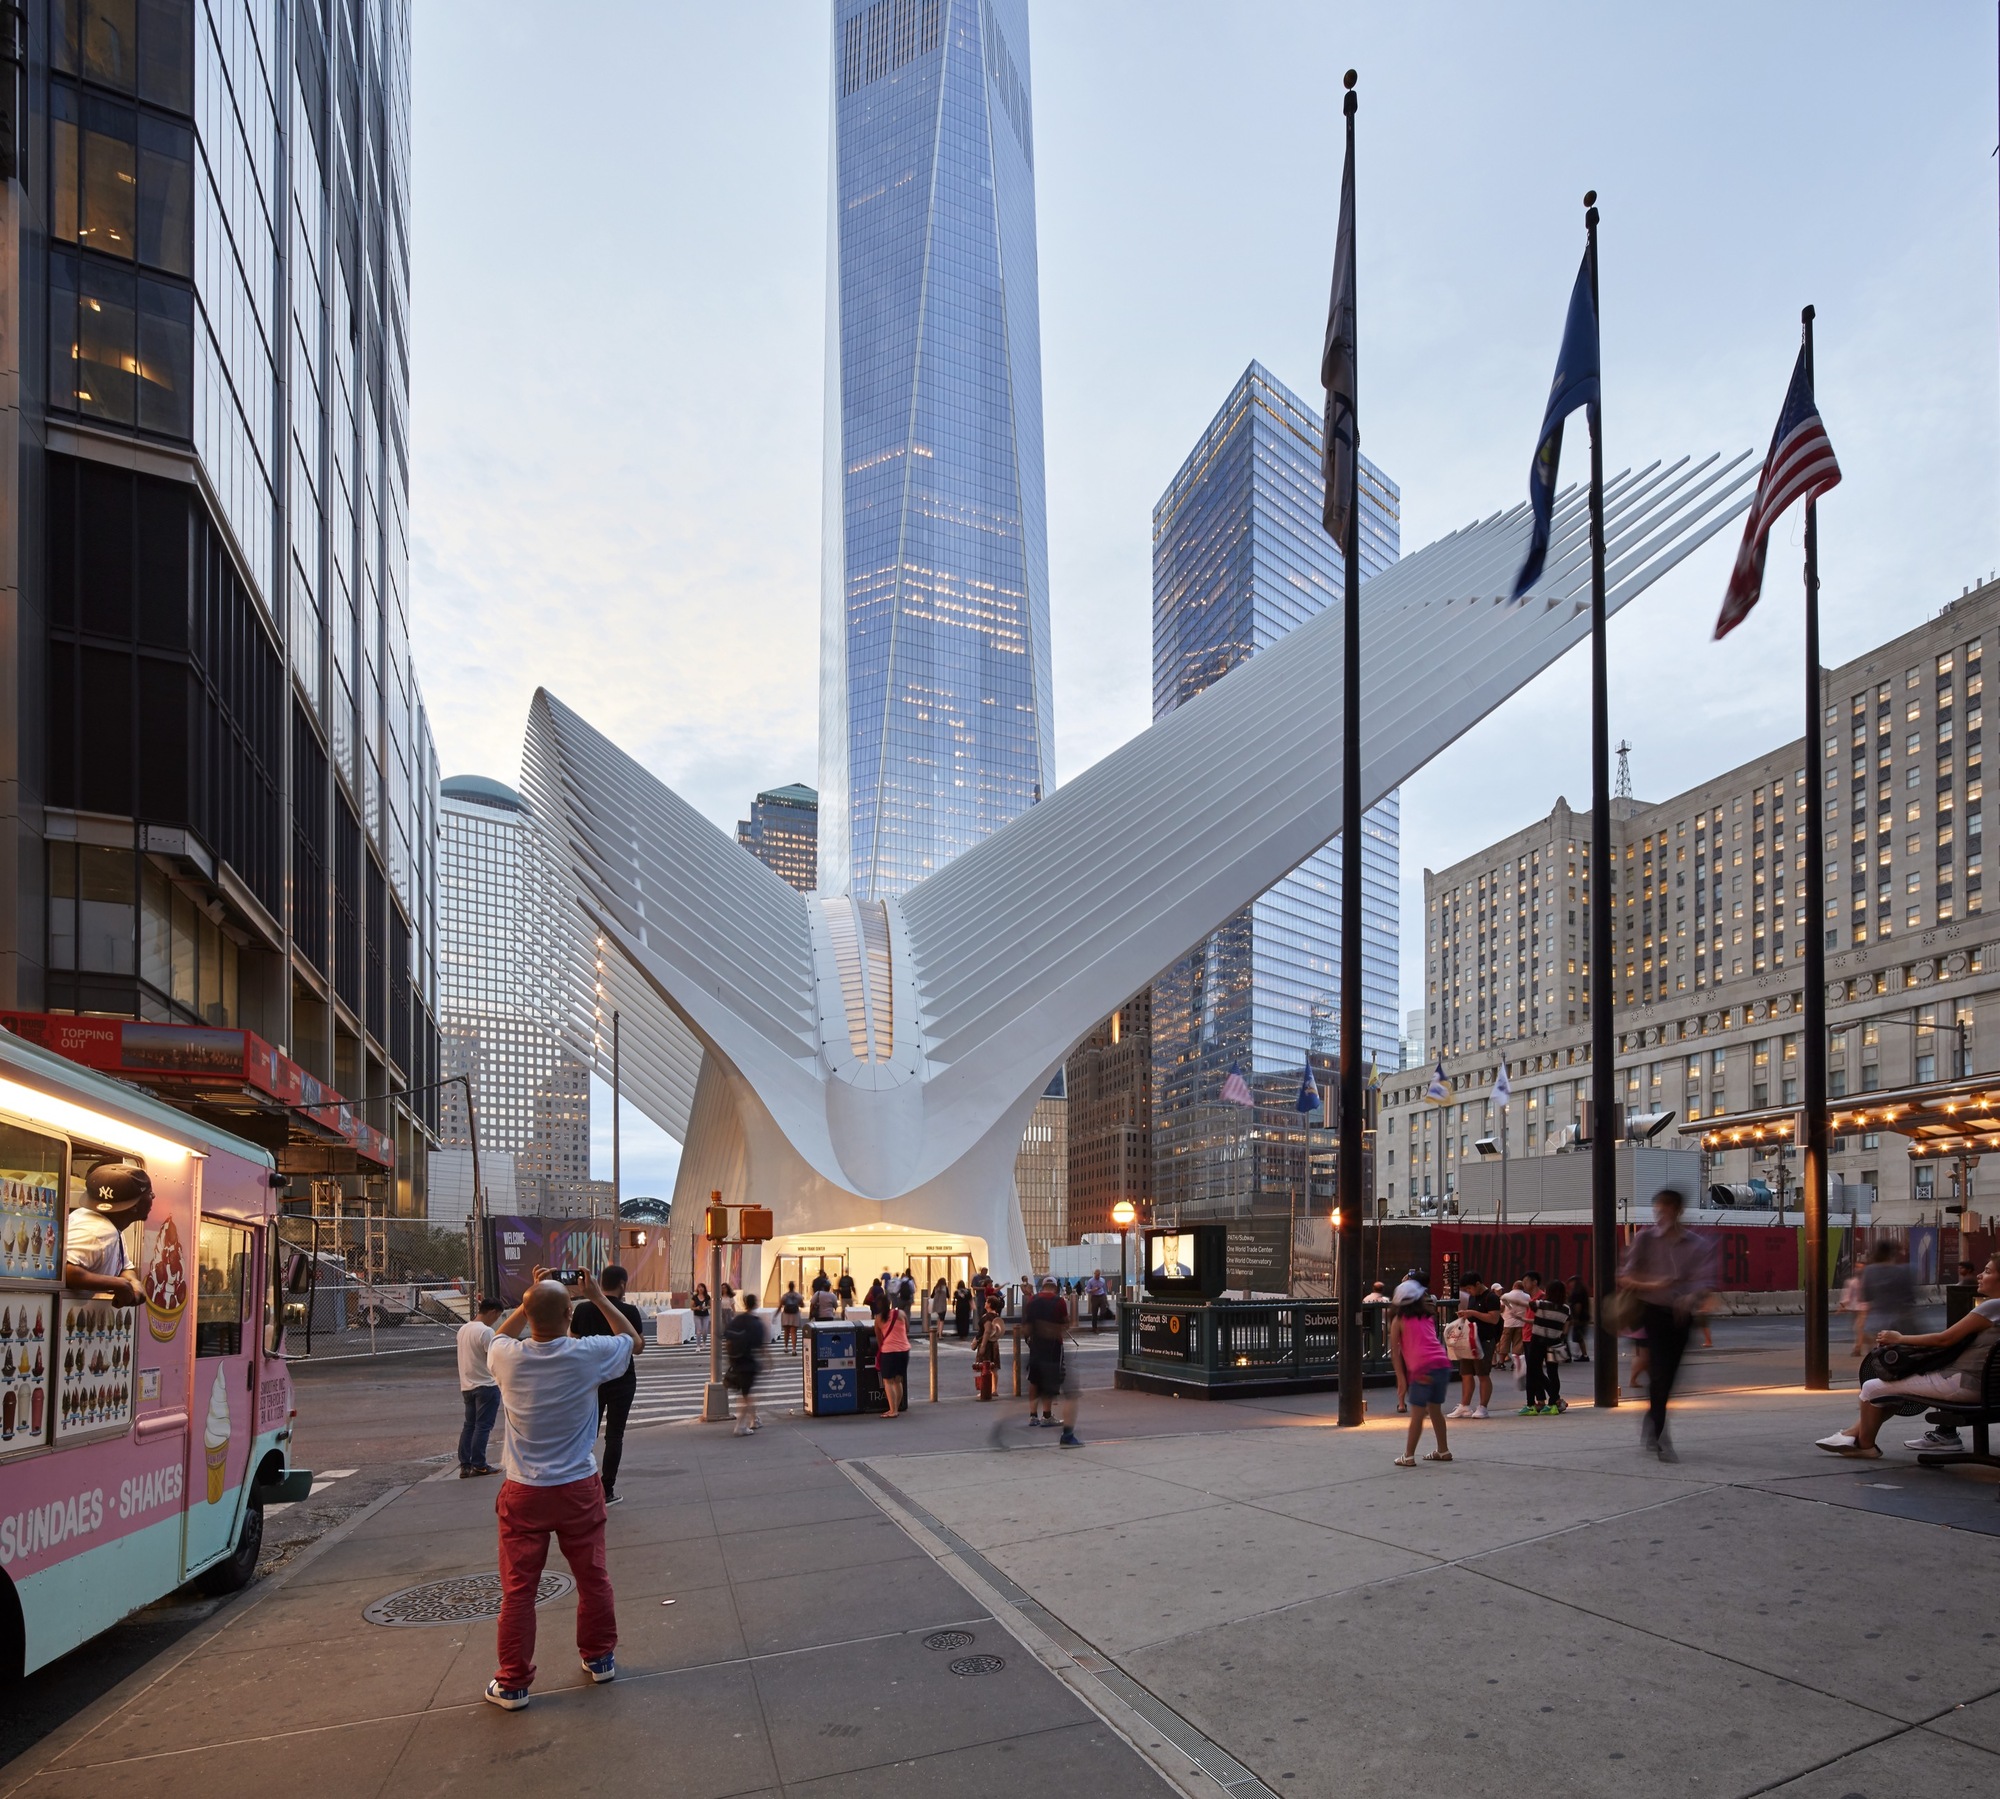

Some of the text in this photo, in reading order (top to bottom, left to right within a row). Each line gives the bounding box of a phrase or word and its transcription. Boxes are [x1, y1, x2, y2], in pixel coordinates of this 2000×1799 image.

[61, 1028, 114, 1041] TOPPING
[61, 1038, 86, 1049] OUT
[503, 1231, 527, 1246] WELCOME,
[504, 1247, 521, 1260] WORLD
[1246, 1258, 1272, 1266] Observatory
[1140, 1314, 1168, 1324] Cortlandt St
[1305, 1314, 1339, 1326] Subwa
[1140, 1323, 1156, 1331] Station
[868, 1391, 887, 1401] TRA
[119, 1463, 183, 1519] SHAKES
[0, 1488, 103, 1565] SUNDAES
